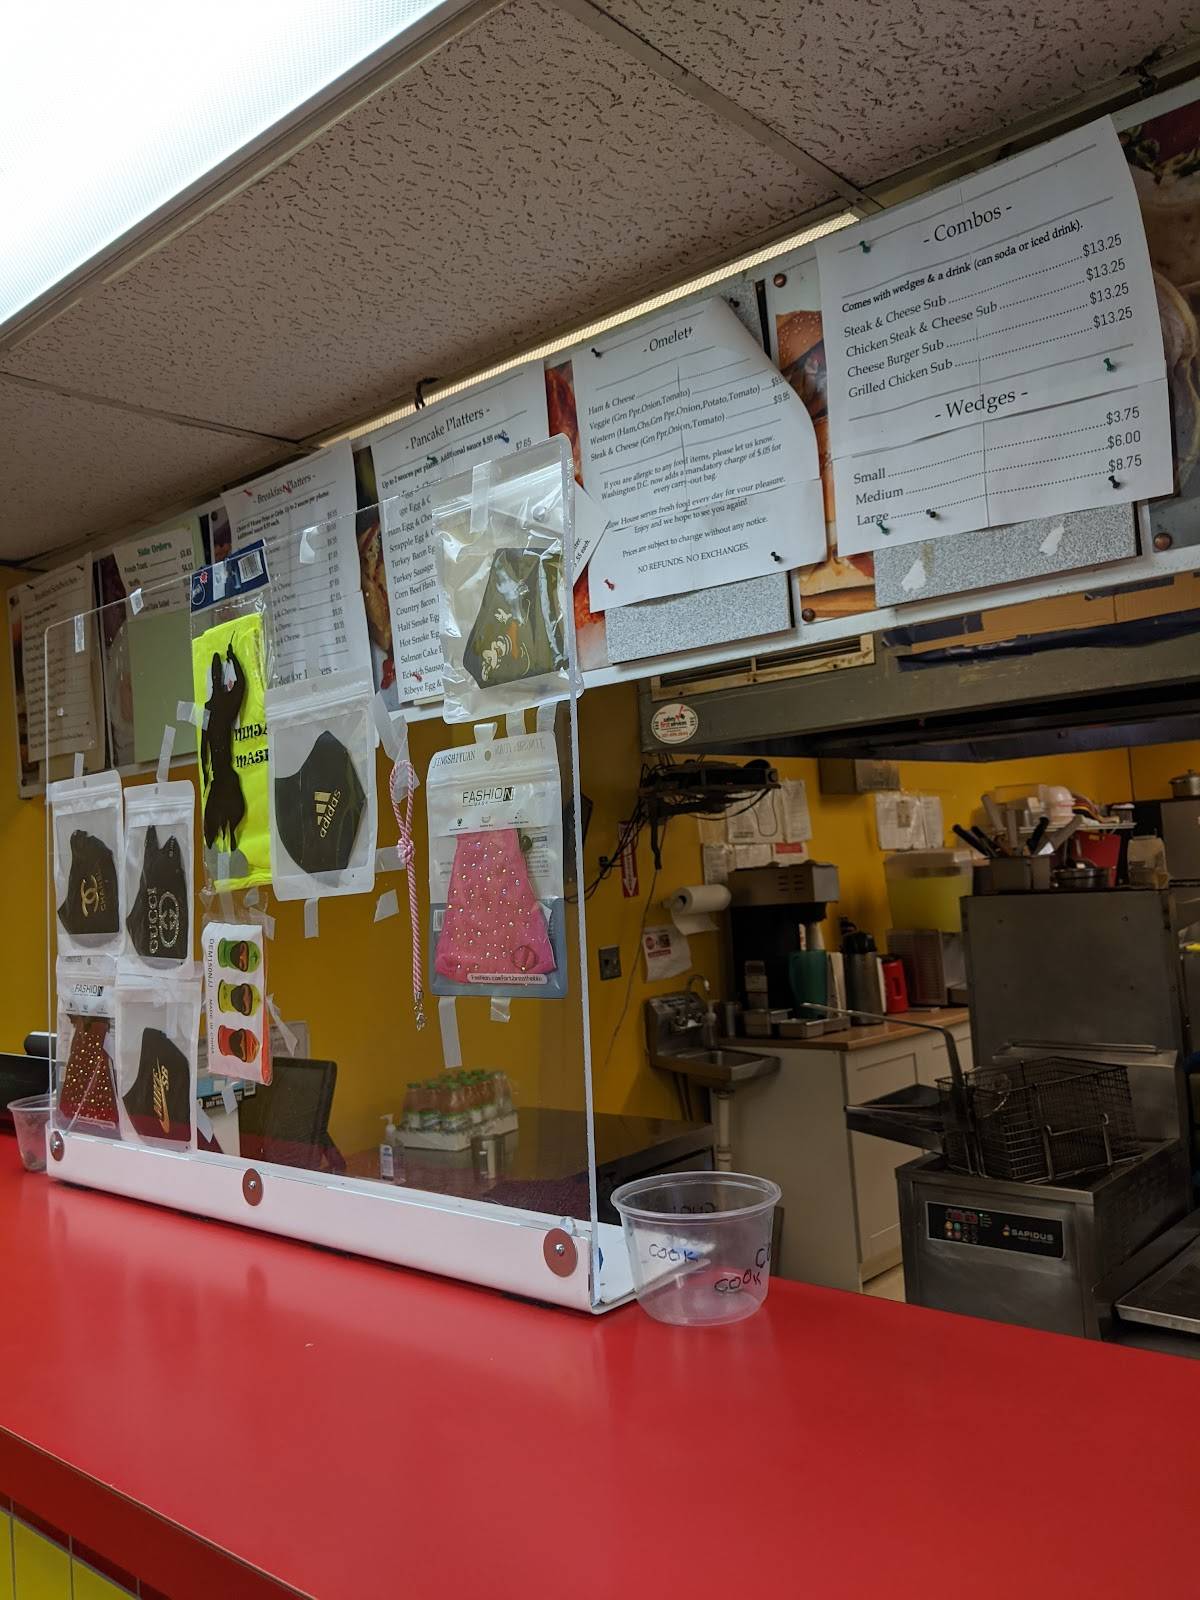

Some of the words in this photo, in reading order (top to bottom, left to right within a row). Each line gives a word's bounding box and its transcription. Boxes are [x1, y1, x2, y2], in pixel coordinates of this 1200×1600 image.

[934, 205, 1002, 242] Combos
[842, 298, 872, 313] Comes
[873, 289, 891, 303] with
[892, 276, 925, 292] wedges
[927, 274, 936, 283] &
[946, 262, 972, 278] drink
[974, 256, 993, 271] (can
[995, 246, 1017, 261] soda
[1019, 243, 1029, 252] or
[1031, 232, 1050, 248] iced
[1052, 219, 1083, 239] drink).
[844, 321, 872, 338] Steak
[875, 317, 883, 328] &
[886, 304, 921, 323] Cheese
[923, 295, 946, 311] Sub
[1083, 233, 1122, 257] $13.25
[846, 338, 888, 358] Chicken
[890, 326, 917, 344] Steak
[919, 322, 928, 333] &
[931, 311, 973, 330] Cheese
[976, 301, 998, 317] Sub
[1086, 258, 1126, 282] $13.25
[847, 360, 885, 378] Cheese
[887, 348, 920, 367] Burger
[922, 339, 944, 354] Sub
[1089, 282, 1129, 305] $13.25
[848, 379, 886, 398] Grilled
[888, 367, 928, 388] Chicken
[930, 358, 953, 374] Sub
[1093, 306, 1133, 329] $13.25
[588, 405, 604, 416] Ham
[605, 401, 611, 409] &
[612, 394, 636, 407] Cheese
[945, 390, 1017, 420] Wedges
[410, 425, 445, 450] Pancake
[446, 407, 485, 432] Platters
[589, 418, 611, 431] Veggie
[590, 432, 616, 446] Western
[591, 449, 607, 460] Steak
[608, 447, 614, 455] &
[615, 440, 640, 453] Cheese
[853, 467, 886, 485] Small
[1106, 406, 1140, 426] $3.75
[601, 485, 636, 500] Washington
[650, 477, 663, 486] now
[665, 470, 679, 481] adds
[685, 461, 723, 476] mandatory
[724, 454, 747, 466] charge
[748, 450, 756, 460] of
[772, 443, 781, 453] for
[609, 480, 621, 490] you
[622, 476, 632, 484] are
[633, 469, 654, 482] allergic
[662, 462, 672, 472] any
[674, 456, 689, 467] food
[712, 447, 734, 461] please
[735, 443, 744, 452] let
[745, 441, 754, 449] us
[855, 486, 904, 506] Medium
[1107, 430, 1141, 450] $6.00
[653, 483, 671, 494] every
[857, 509, 890, 527] Large
[1108, 454, 1142, 473] $8.75
[621, 514, 639, 525] House
[640, 509, 658, 519] serves
[658, 503, 675, 514] fresh
[676, 499, 691, 510] food
[691, 495, 711, 507] every
[711, 490, 724, 500] day
[725, 487, 735, 497] for
[736, 484, 754, 494] your
[651, 519, 662, 529] and
[663, 517, 673, 525] we
[674, 512, 692, 524] hope
[692, 511, 701, 519] to
[701, 509, 711, 517] see
[711, 504, 725, 516] you
[726, 497, 748, 512] again!
[402, 521, 415, 533] Egg
[638, 545, 647, 553] are
[647, 538, 669, 551] subject
[670, 537, 678, 545] to
[678, 532, 703, 544] change
[704, 524, 732, 538] without
[732, 521, 745, 531] any
[389, 537, 414, 553] Scrapple
[391, 556, 411, 568] Turkey
[393, 571, 413, 584] Turkey
[413, 563, 434, 578] Sausage
[638, 564, 648, 574] NO
[686, 553, 700, 563] NO
[394, 587, 409, 600] Corn
[409, 585, 423, 595] Beef
[422, 579, 437, 590] Hash
[396, 602, 420, 616] Country
[420, 596, 437, 608] Bacon
[397, 621, 411, 633] Half
[411, 616, 429, 629] Smoke
[399, 637, 412, 648] Hot
[412, 633, 430, 645] Smoke
[400, 652, 422, 664] Salmon
[422, 647, 438, 660] Cake
[404, 684, 424, 697] Ribeye
[424, 682, 436, 692] Egg
[462, 785, 515, 804] FASHION
[319, 788, 342, 839] adidas
[147, 886, 159, 955] GUCCI
[1011, 1228, 1054, 1242] SAPIDUS
[648, 1242, 699, 1263] COOK
[714, 1269, 762, 1293] COOK
